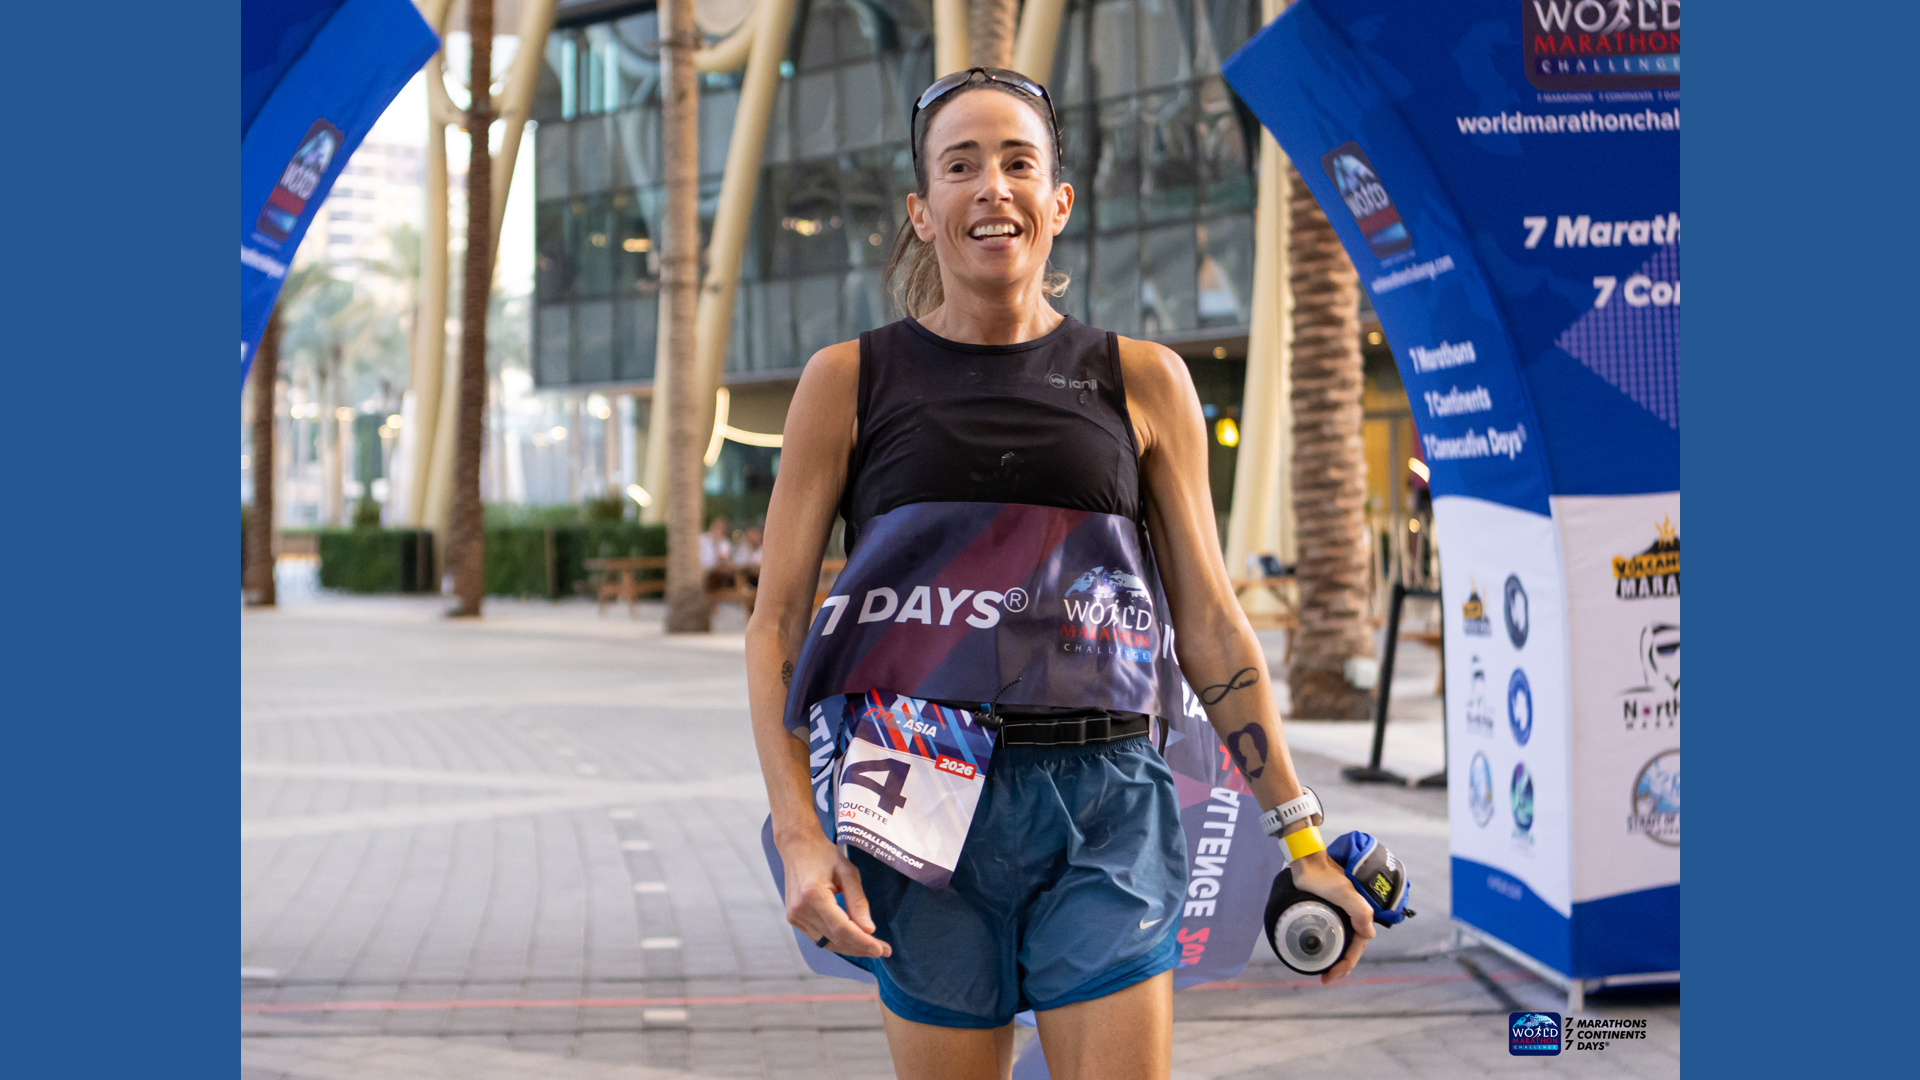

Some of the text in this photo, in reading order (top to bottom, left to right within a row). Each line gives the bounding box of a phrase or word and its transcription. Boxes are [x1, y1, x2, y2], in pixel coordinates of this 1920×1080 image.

[1523, 215, 1548, 249] 7
[1592, 275, 1617, 308] 7
[821, 594, 850, 637] 7
[1060, 623, 1150, 648] MARATHON
[902, 718, 937, 738] ASIA
[939, 758, 974, 776] 2026
[840, 757, 911, 815] 4
[838, 810, 857, 819] SA)
